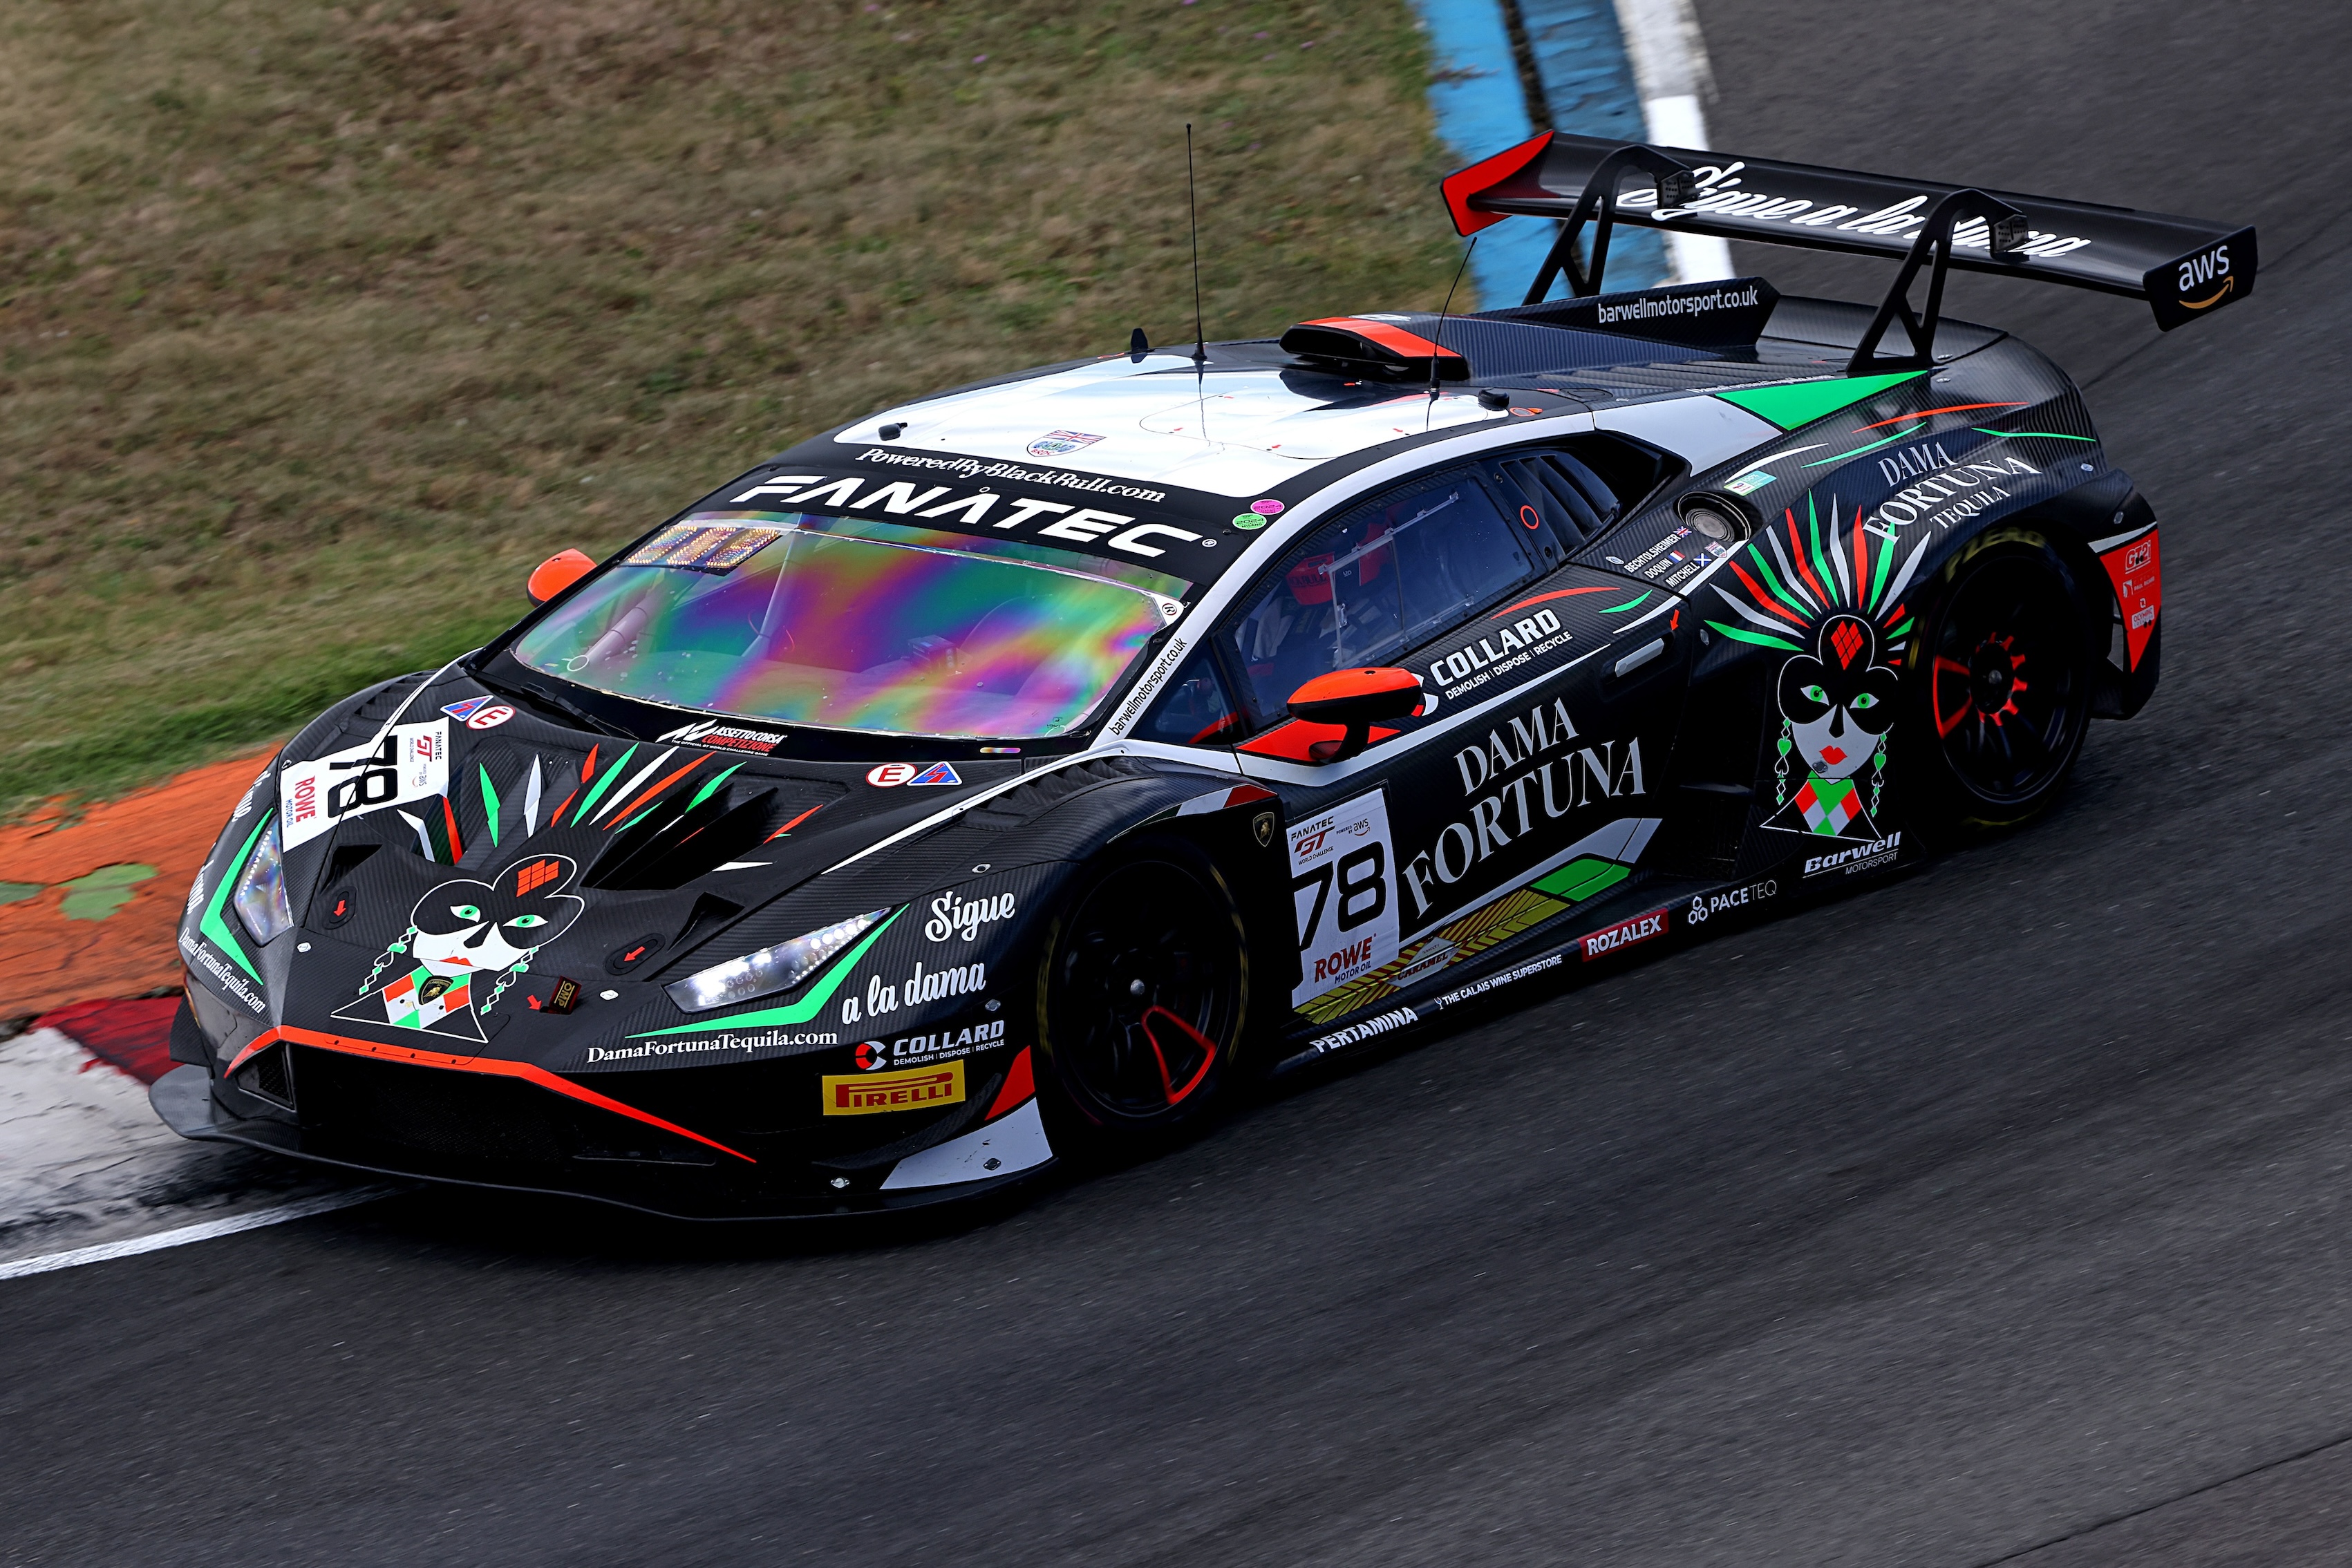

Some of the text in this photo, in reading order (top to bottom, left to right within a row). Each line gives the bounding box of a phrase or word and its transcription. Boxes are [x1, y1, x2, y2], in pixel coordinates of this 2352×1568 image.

[1789, 205, 1859, 227] a
[1836, 195, 1928, 235] la
[2179, 245, 2230, 291] aws
[1597, 285, 1759, 324] barwellmotorsport.co.uk
[1878, 442, 1958, 487] DAMA
[728, 475, 1205, 558] FANATEC
[1862, 456, 2042, 546] FORTUNA
[1929, 486, 2011, 529] TEQUILA
[1624, 533, 1682, 574] BECHTOLSHEIMER
[1644, 558, 1673, 580] DOQUIN
[1665, 562, 1701, 588] MITCHELL
[1430, 608, 1562, 687] COLLARD
[1445, 630, 1573, 700] DEMOLISH DISPOSE RECYCLE
[1108, 637, 1187, 736] barwellmotorsport.co.uk
[680, 740, 702, 748] OFFICIAL
[726, 747, 755, 755] CHALLENGE
[701, 734, 778, 753] COMPETIZIONE
[1453, 697, 1580, 796] DAMA
[328, 735, 398, 818] 78
[419, 775, 427, 786] aws
[877, 766, 906, 783] E
[285, 798, 293, 817] MOTOR
[294, 775, 316, 824] ROWE
[1290, 815, 1334, 842] FANATEC
[1336, 825, 1353, 835] POWERED
[1353, 818, 1370, 833] aws
[1402, 737, 1646, 920] FORTUNA
[1298, 845, 1335, 866] WORLD CHALLENGE
[1804, 831, 1901, 873] Barwell
[1845, 851, 1899, 876] MOTORSPORT
[1292, 840, 1386, 952] 78
[1711, 879, 1778, 914] PACETEQ
[924, 891, 1016, 943] Sigue
[1586, 914, 1662, 956] ROZALEX
[178, 927, 267, 1014] DamaFortunaTequila.com
[1314, 936, 1373, 984] ROWE
[1334, 960, 1372, 984] MOTOR OIL
[1442, 954, 1563, 1006] THE CALAIS WINE SUPERSTORE
[558, 981, 573, 1007] OMP
[842, 961, 986, 1025] a la dama
[586, 1029, 838, 1064] DamaFortunaTequila.com
[893, 1020, 1005, 1056] COLLARD
[1309, 1006, 1419, 1053] PERTAMINA
[894, 1039, 1005, 1066] DEMOLISH DISPOSE RECYCLE
[835, 1071, 954, 1108] PIRELLI
